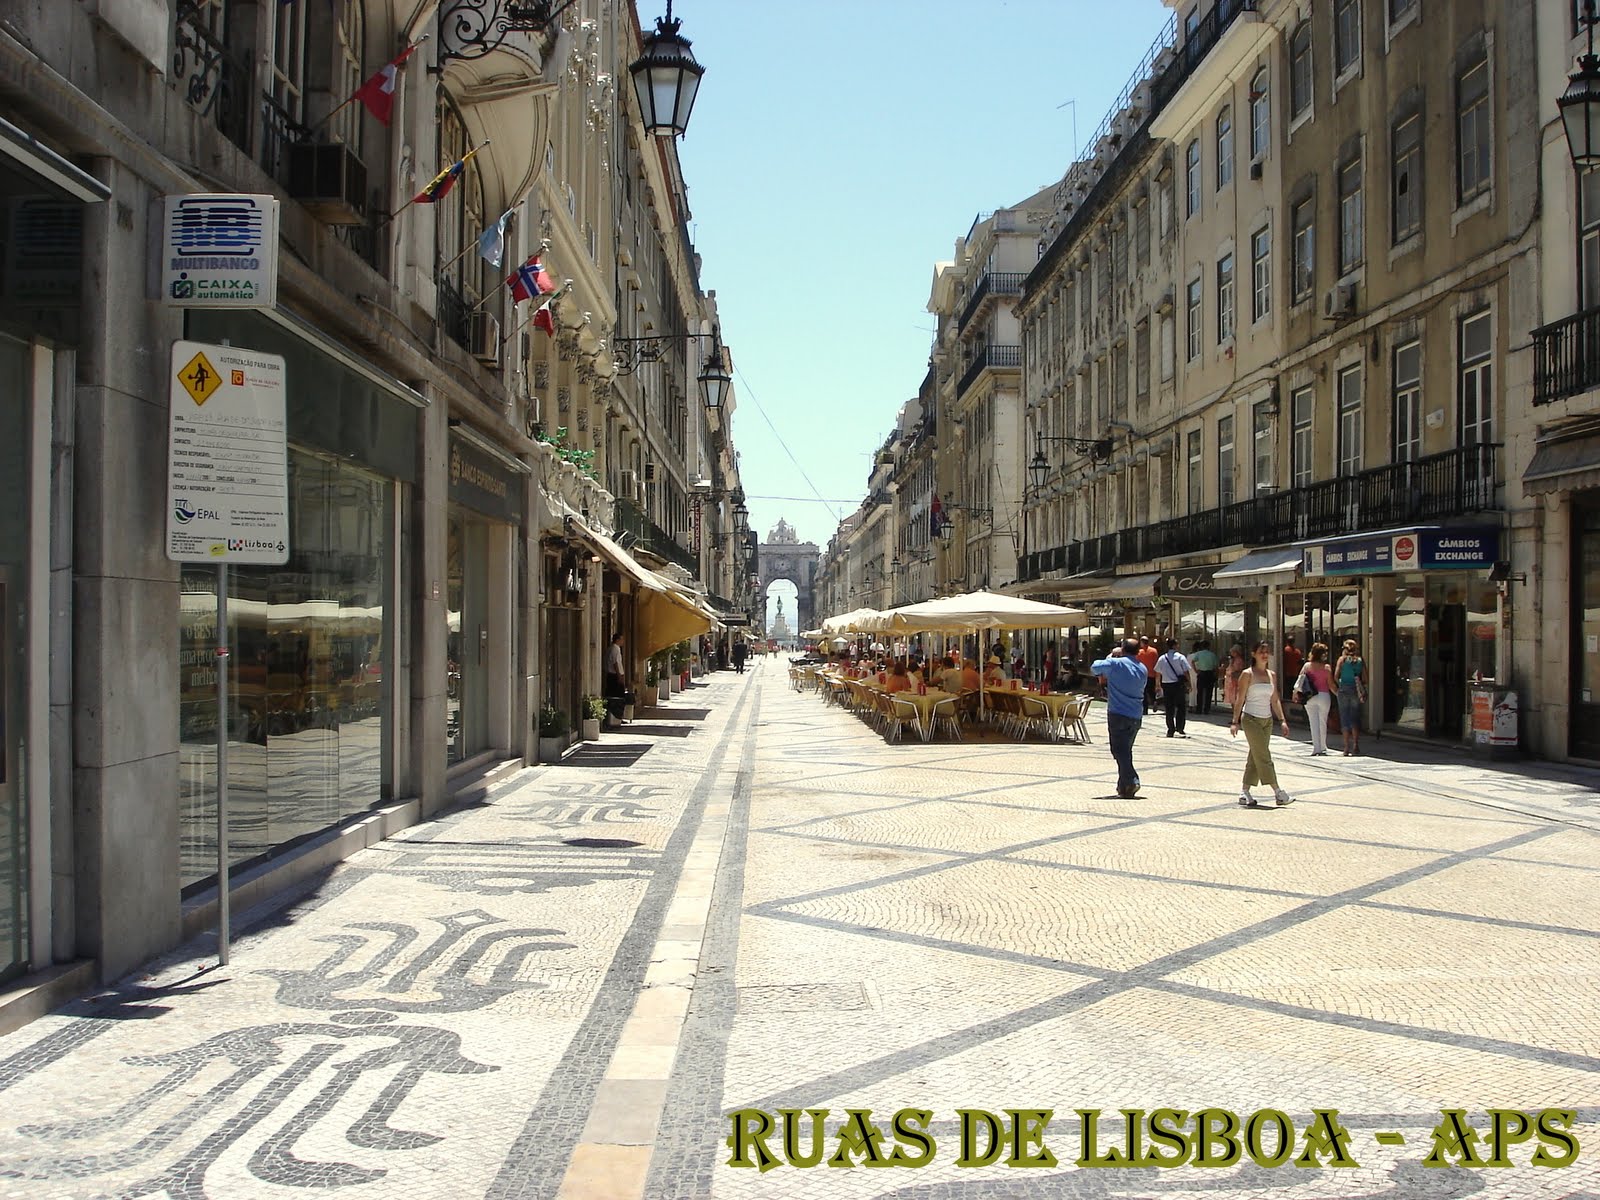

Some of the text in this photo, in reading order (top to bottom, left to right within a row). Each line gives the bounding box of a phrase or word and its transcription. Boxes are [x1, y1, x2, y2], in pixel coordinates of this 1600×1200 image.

[171, 257, 259, 270] MULTIBANCO
[197, 280, 253, 289] CAIXA
[197, 290, 253, 299] automático
[220, 356, 254, 367] AUTORIZAÇÃO
[254, 361, 267, 369] PARA
[197, 508, 220, 521] EPAL
[1438, 538, 1480, 549] CÂMBIOS
[1435, 552, 1484, 561] EXCHANGE
